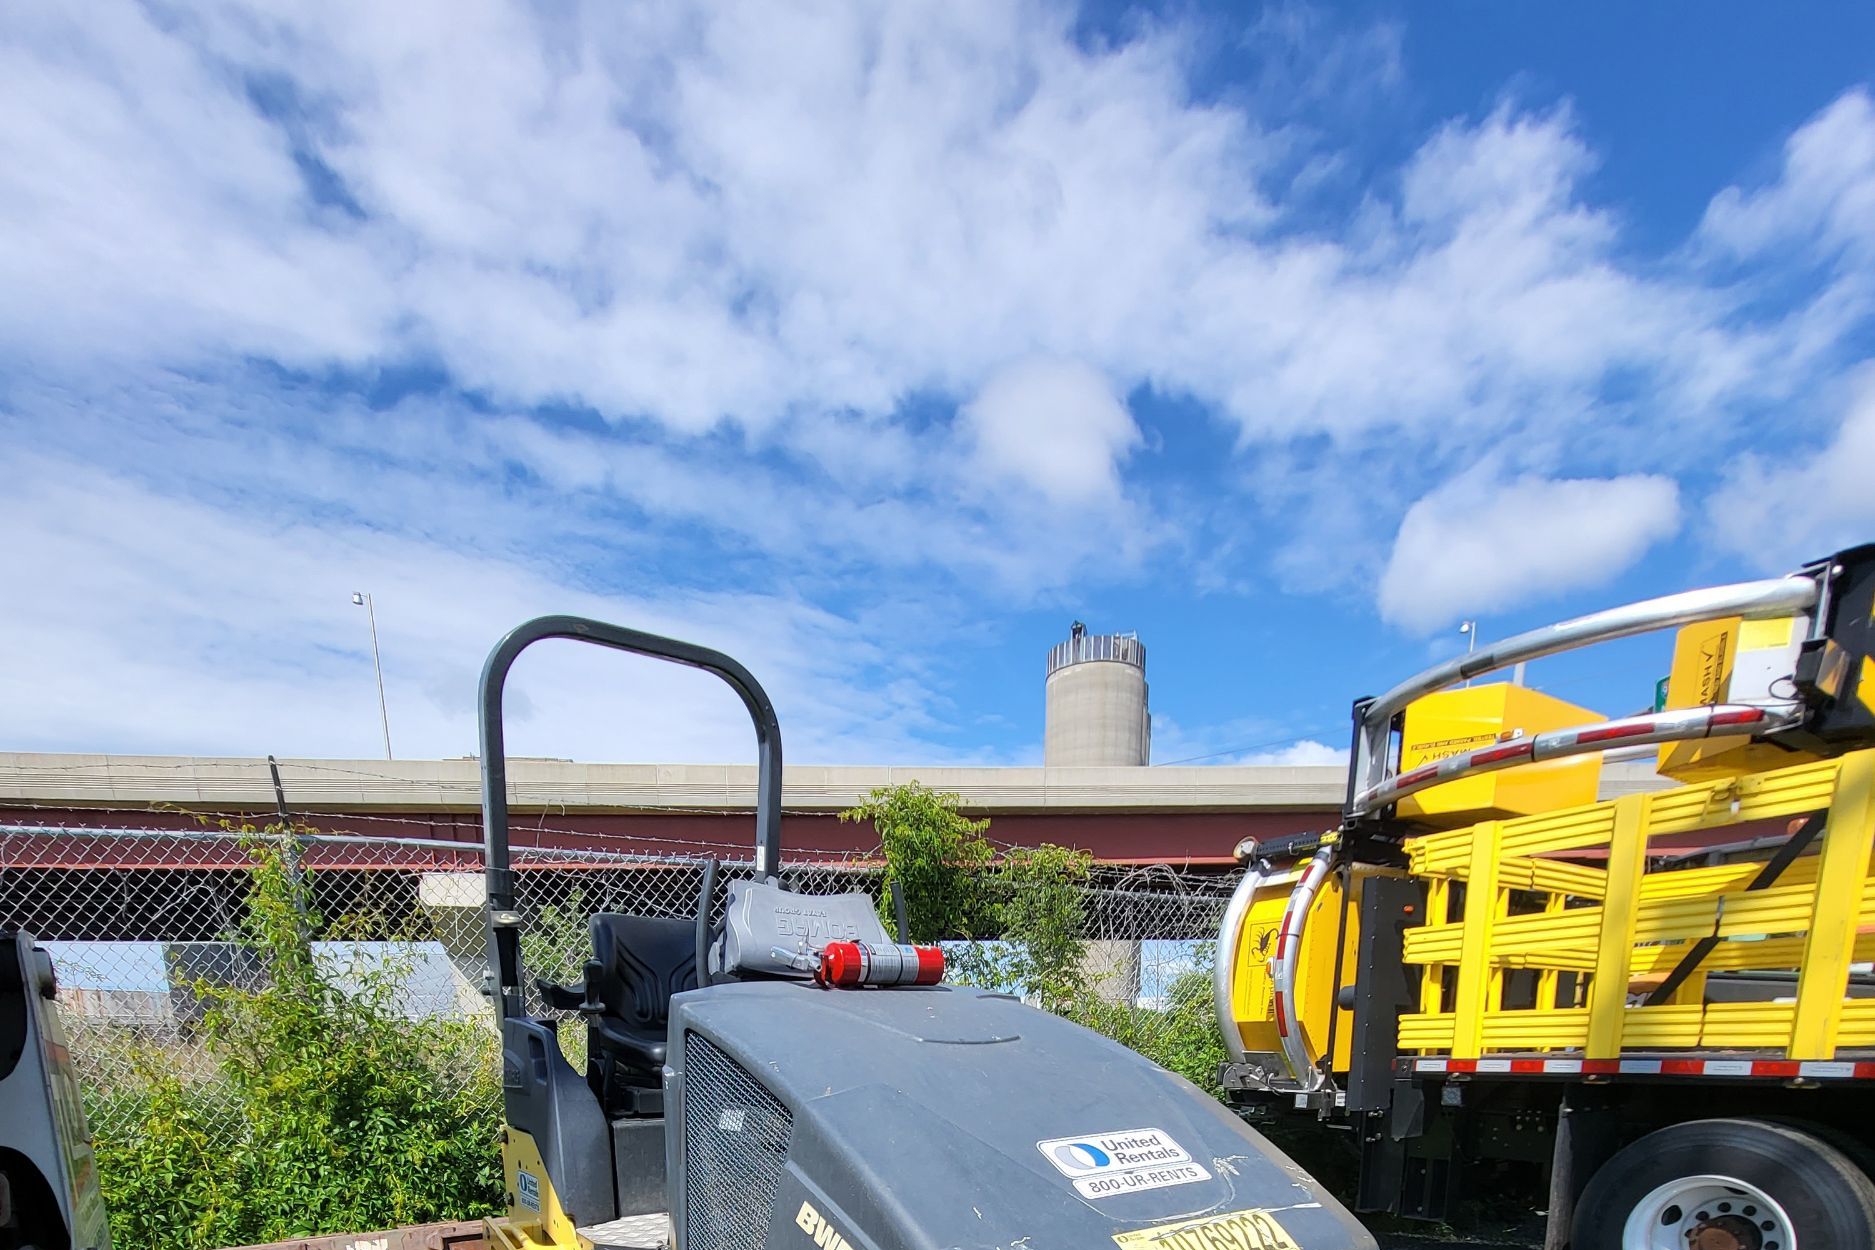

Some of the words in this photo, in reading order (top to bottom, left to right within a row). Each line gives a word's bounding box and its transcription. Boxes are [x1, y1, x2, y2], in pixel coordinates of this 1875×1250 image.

[1101, 1134, 1161, 1151] United
[1114, 1146, 1180, 1165] Rentals
[1088, 1167, 1198, 1193] 800-UR-RENTS
